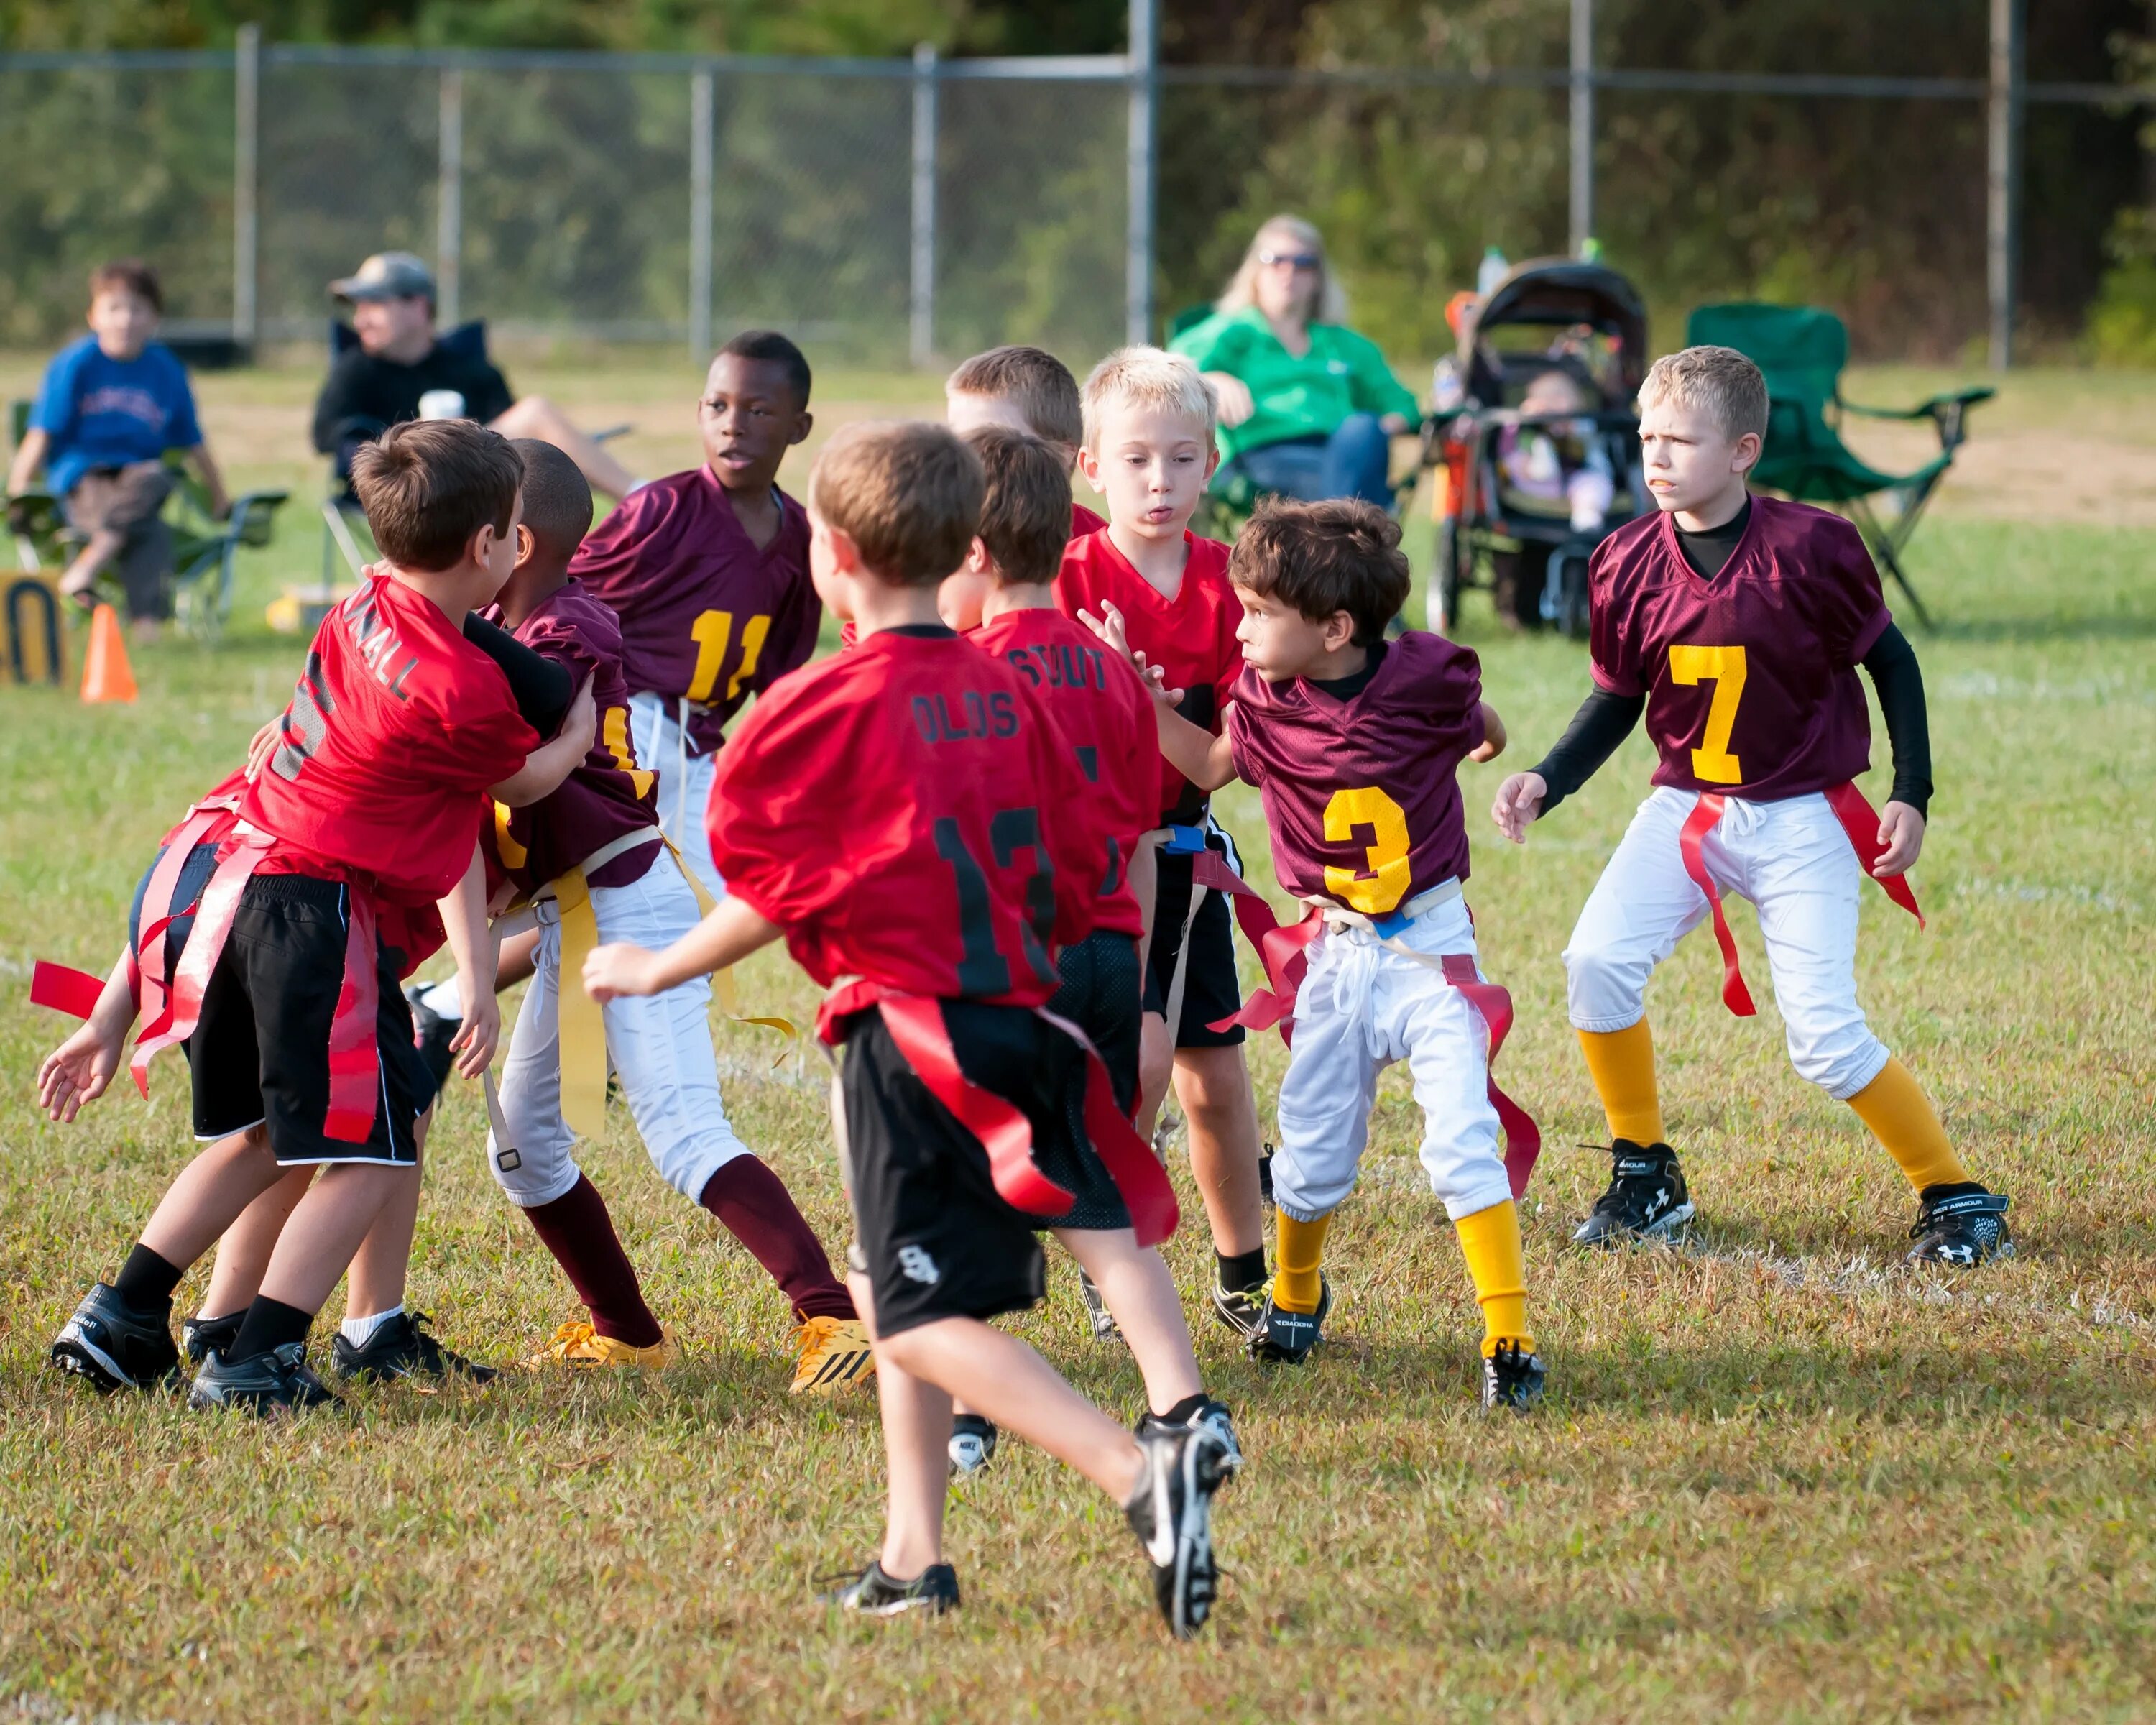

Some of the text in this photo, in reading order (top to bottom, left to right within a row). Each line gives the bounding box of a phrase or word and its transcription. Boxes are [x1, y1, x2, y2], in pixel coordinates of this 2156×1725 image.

[686, 609, 772, 708] 11
[1008, 644, 1106, 690] STOUT
[912, 691, 1020, 744] OLDS
[1669, 645, 1747, 784] 7
[1323, 786, 1411, 914] 3
[1950, 1200, 1982, 1210] ARMOUR
[959, 1441, 977, 1451] NIKE
